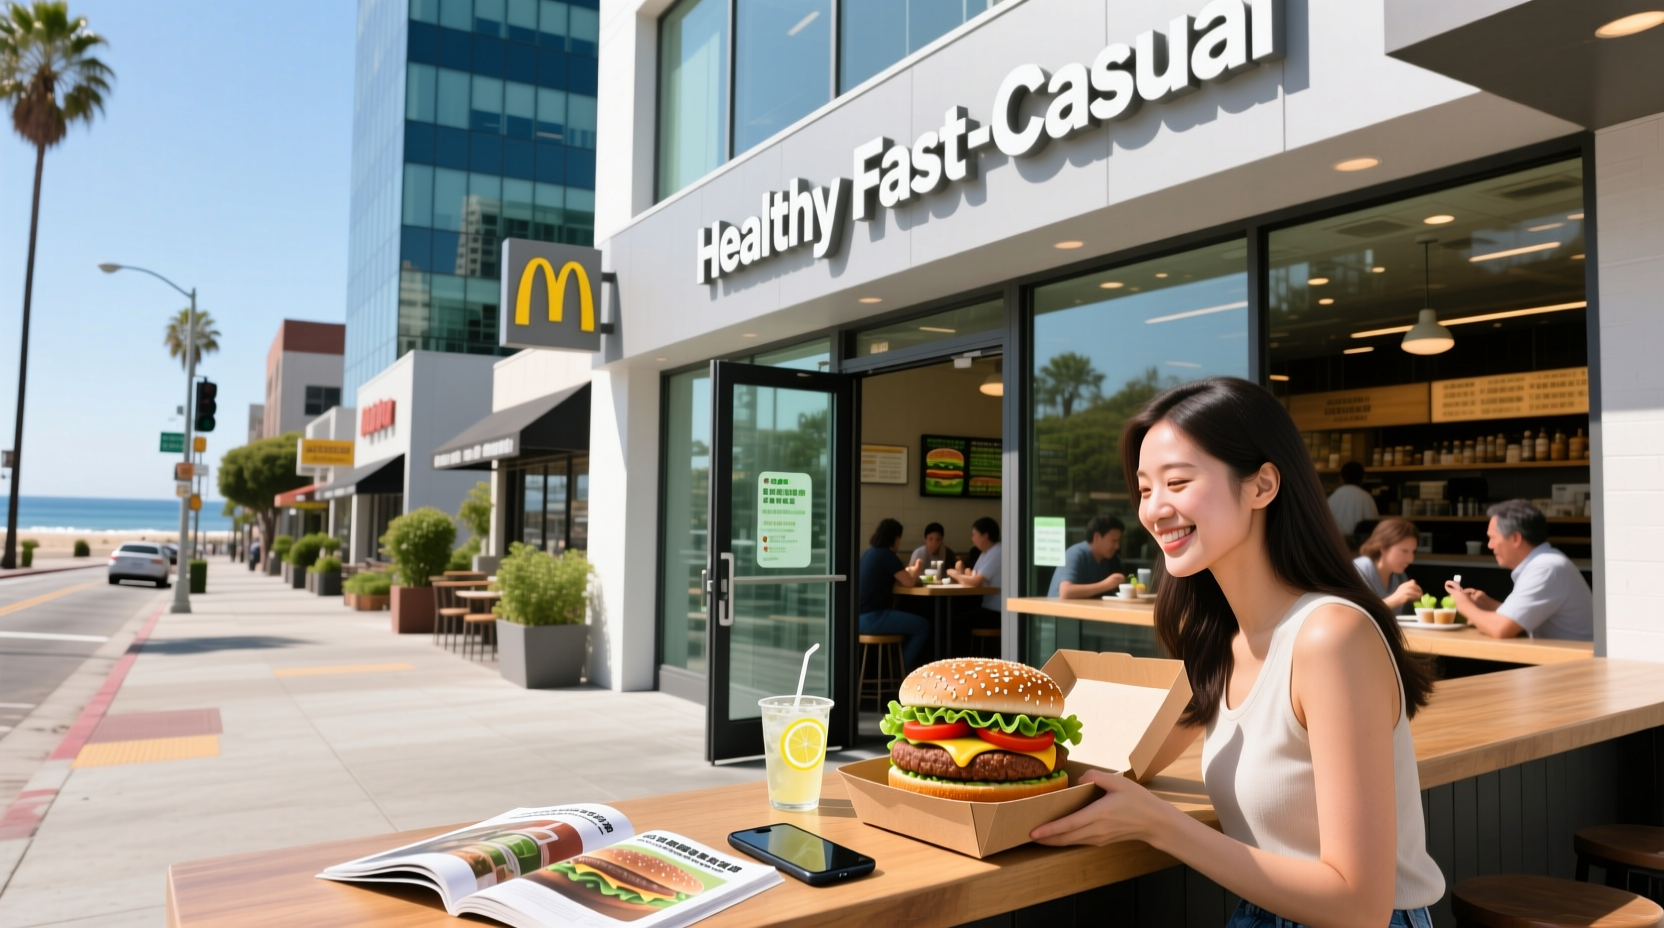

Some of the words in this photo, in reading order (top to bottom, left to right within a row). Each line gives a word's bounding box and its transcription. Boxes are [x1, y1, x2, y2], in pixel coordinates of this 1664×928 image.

[697, 177, 843, 284] Healthy
[853, 0, 1273, 221] Fast-Casual
[514, 257, 595, 332] M
